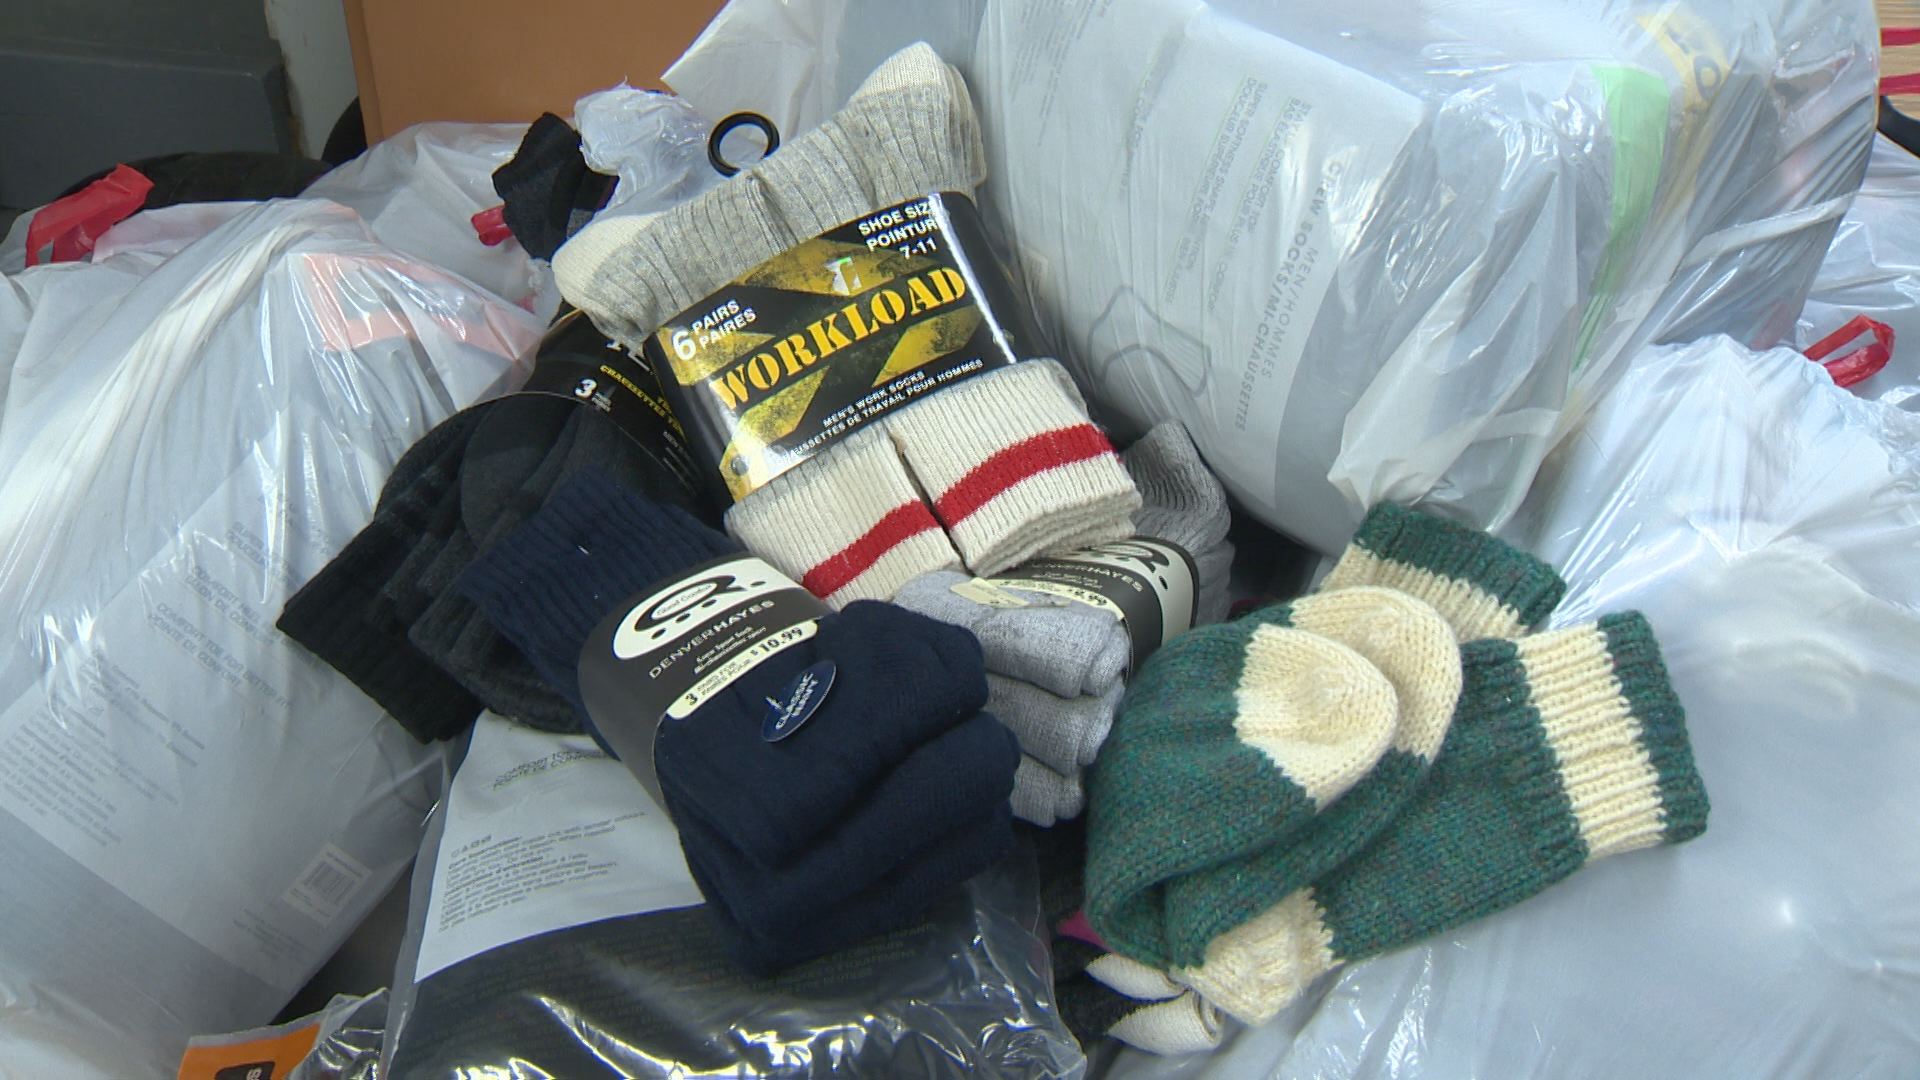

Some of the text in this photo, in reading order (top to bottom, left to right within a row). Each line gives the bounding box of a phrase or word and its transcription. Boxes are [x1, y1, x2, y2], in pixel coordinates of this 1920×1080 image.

[858, 200, 936, 236] SHOE SIZ
[866, 215, 941, 252] POINTUR
[899, 237, 937, 260] 7-11
[692, 299, 740, 335] PAIRS
[698, 307, 757, 348] PAIRES
[672, 329, 697, 361] 6
[709, 266, 967, 411] WORKLOAD
[574, 378, 598, 398] 3
[822, 370, 926, 428] MEN'S WORK SOCKS
[847, 413, 862, 428] DE
[862, 393, 906, 418] TRAVAIL
[906, 376, 937, 397] POUR
[937, 358, 985, 384] HOMMES
[685, 693, 698, 706] 3
